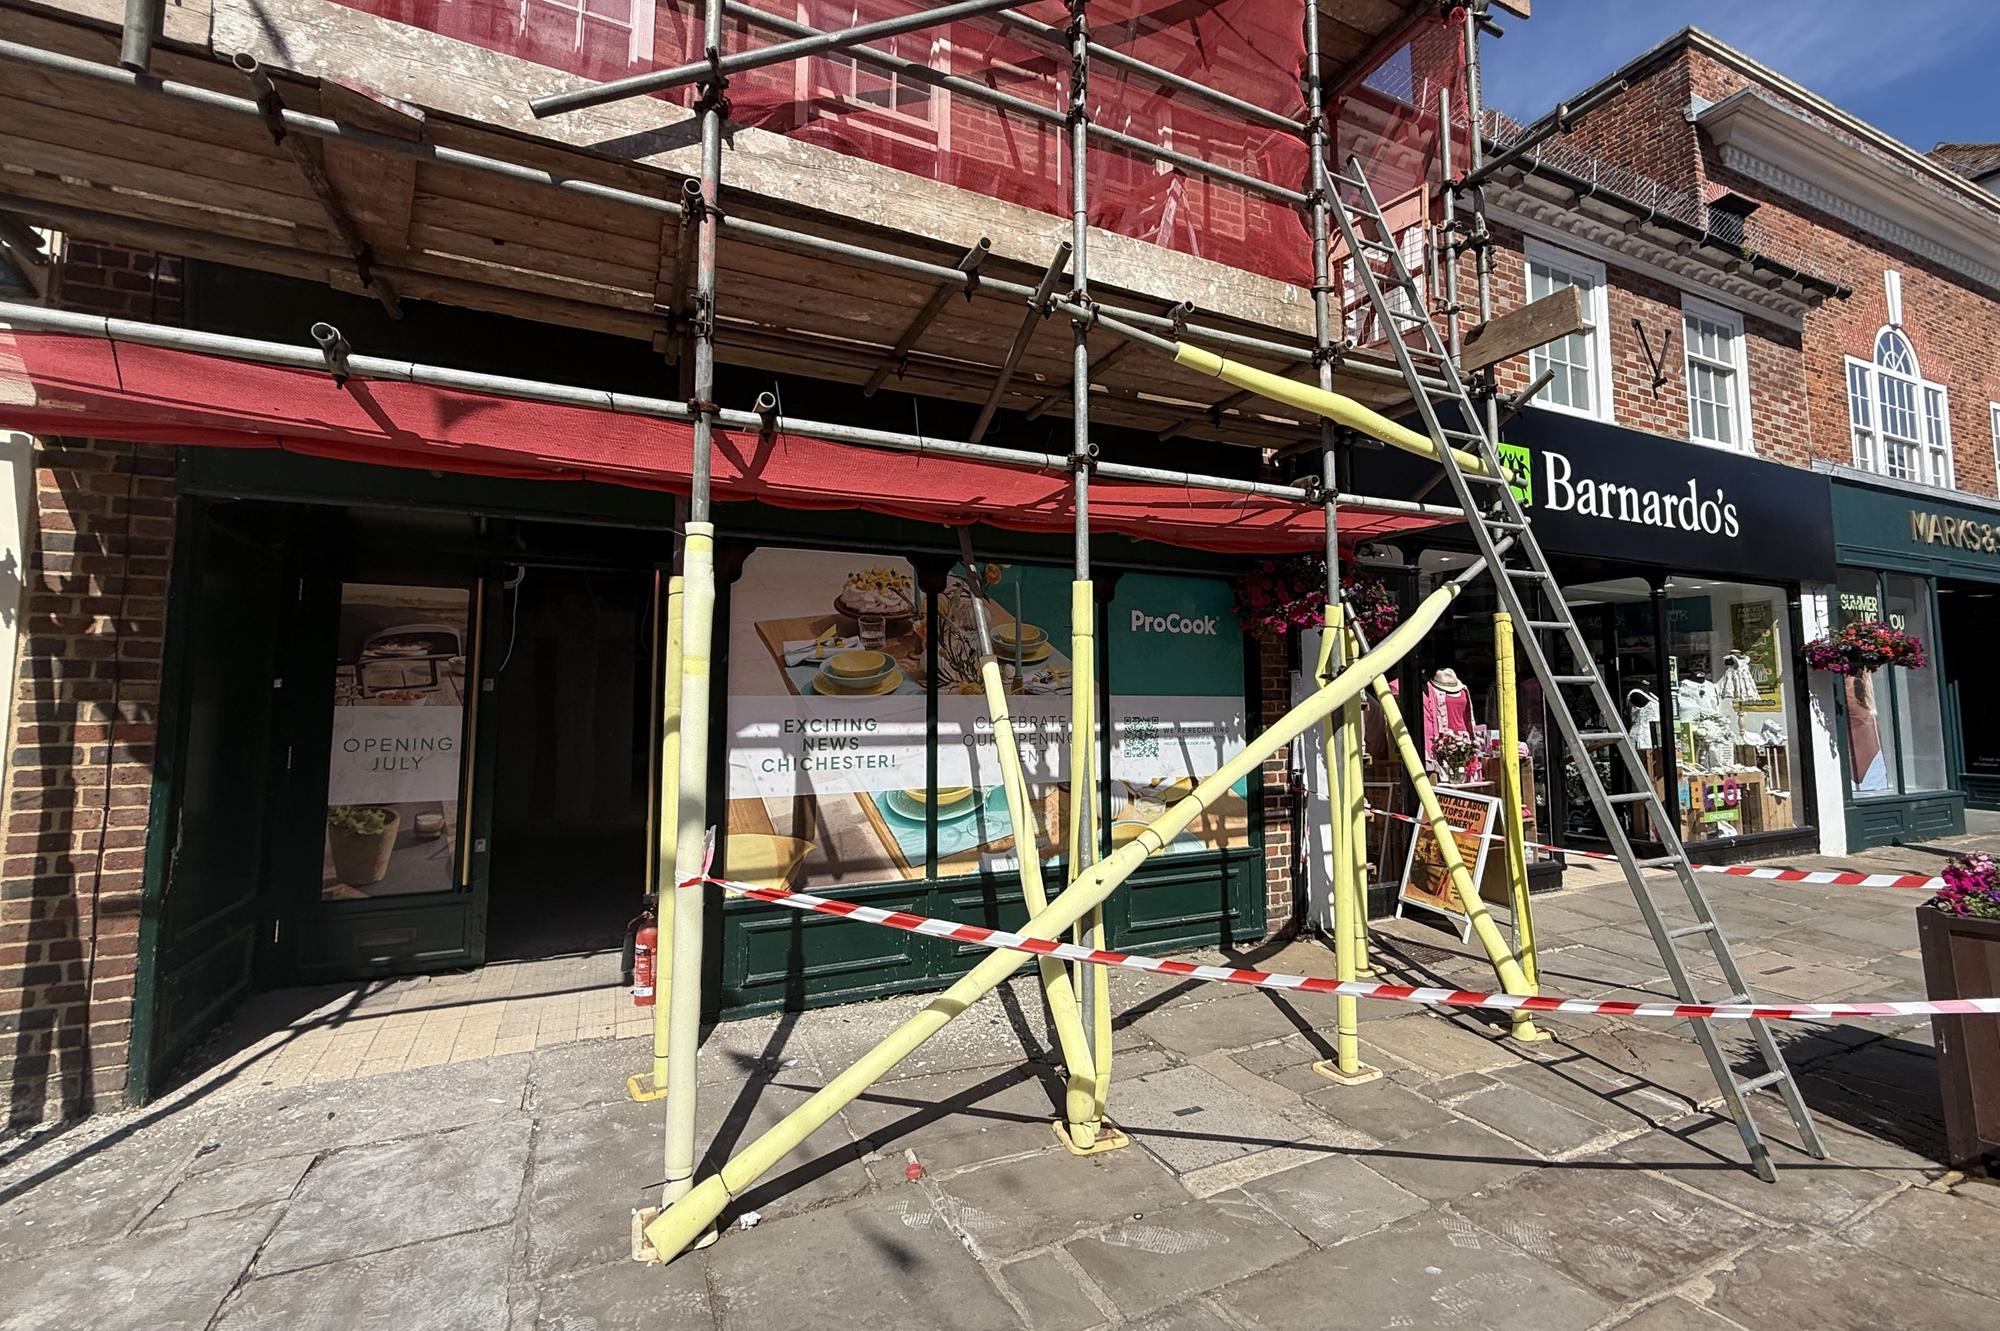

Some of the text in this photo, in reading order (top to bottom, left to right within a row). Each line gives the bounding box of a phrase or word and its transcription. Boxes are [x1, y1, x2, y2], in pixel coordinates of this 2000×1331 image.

[1541, 450, 1740, 538] Barnardo's
[1840, 593, 1878, 612] SUMMER
[1131, 609, 1217, 635] ProCook
[1889, 613, 1905, 630] OU
[783, 717, 878, 733] EXCITING
[975, 715, 1067, 729] CEEBRATE
[1187, 726, 1230, 734] RECRUITING
[343, 736, 454, 753] OPENING
[802, 737, 860, 752] NEWS
[371, 755, 424, 771] JULY
[760, 754, 897, 773] CHICHESTER!
[1440, 805, 1481, 822] PTOPS AND
[1452, 797, 1466, 808] ALL
[1466, 800, 1488, 813] ABOU
